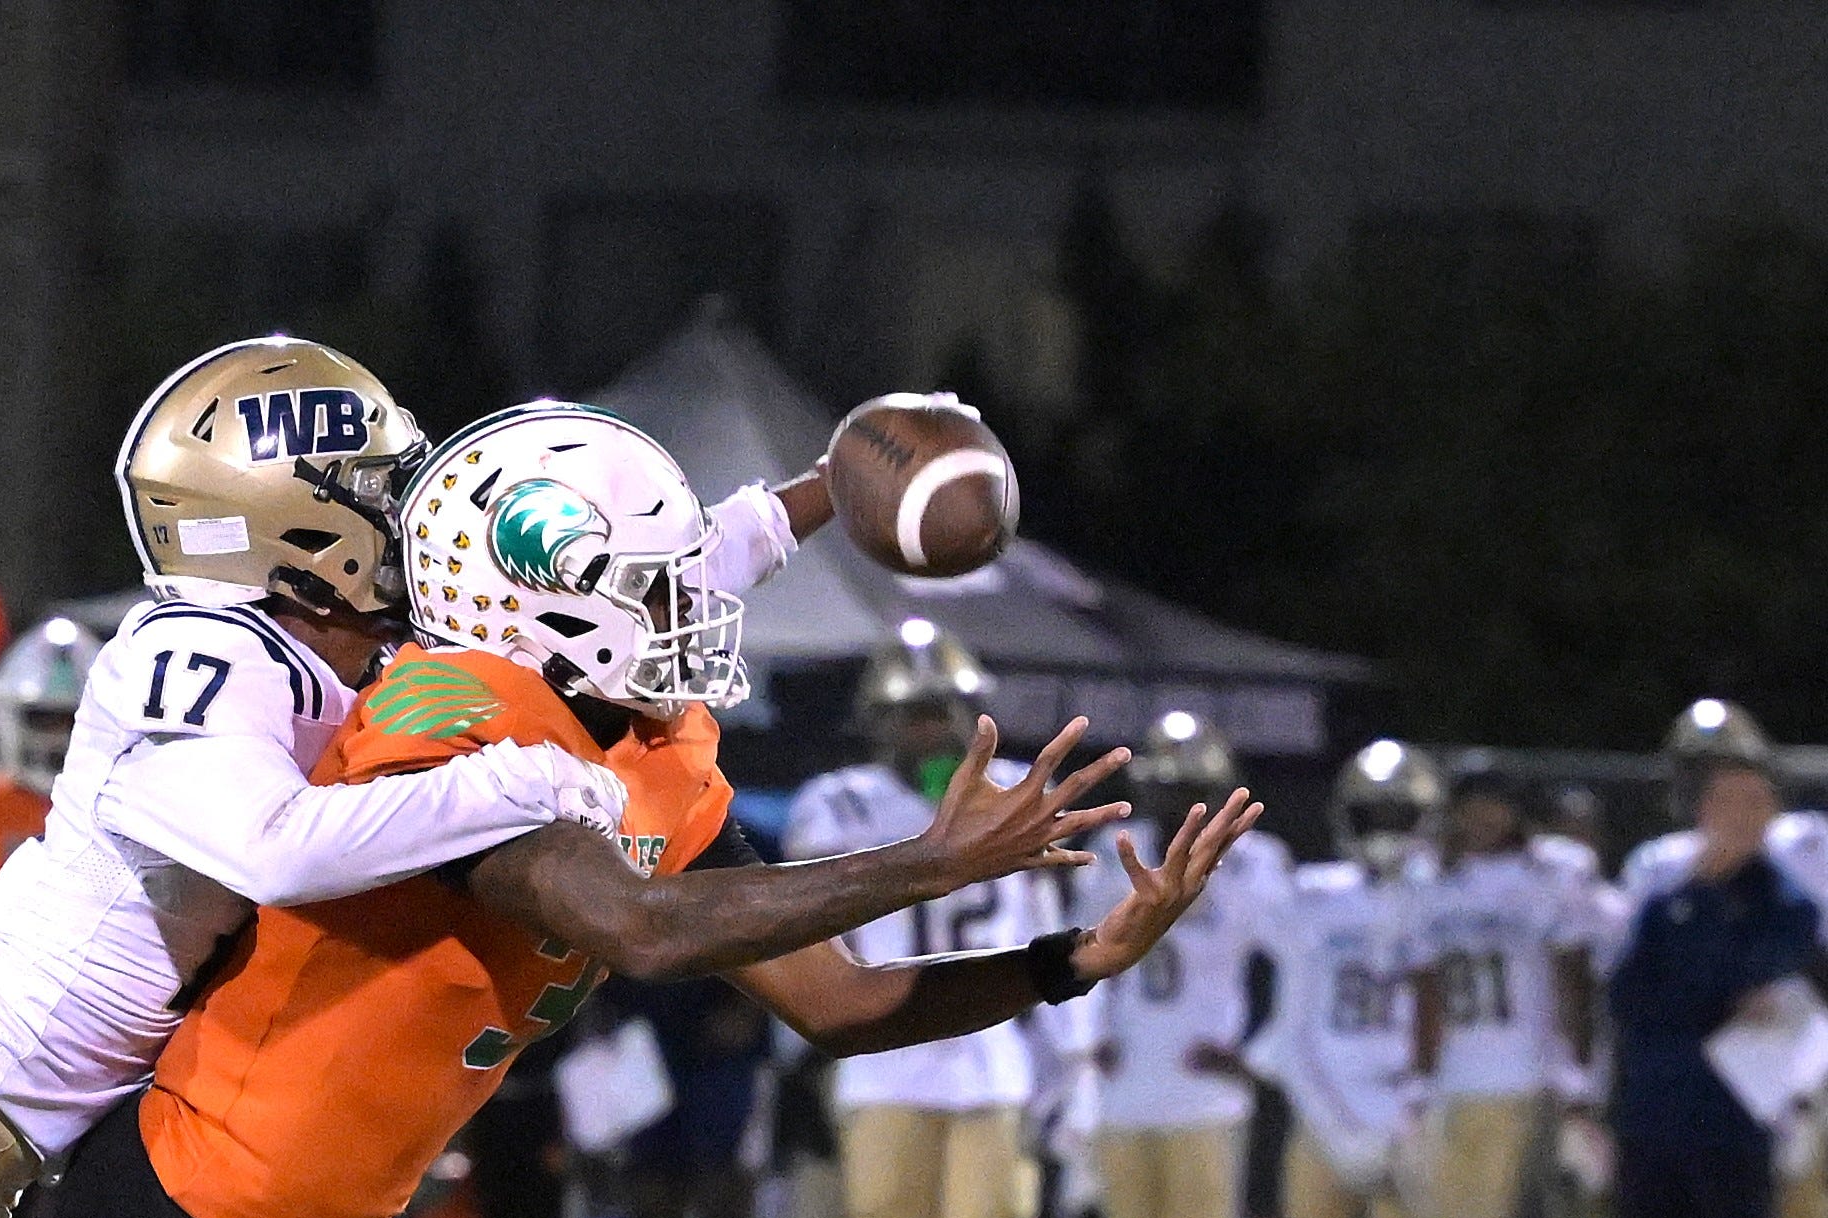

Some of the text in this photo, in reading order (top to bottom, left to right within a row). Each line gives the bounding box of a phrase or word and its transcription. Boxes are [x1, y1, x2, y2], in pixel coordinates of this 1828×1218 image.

[236, 388, 369, 464] WB
[153, 525, 170, 544] 17
[143, 650, 233, 727] 17
